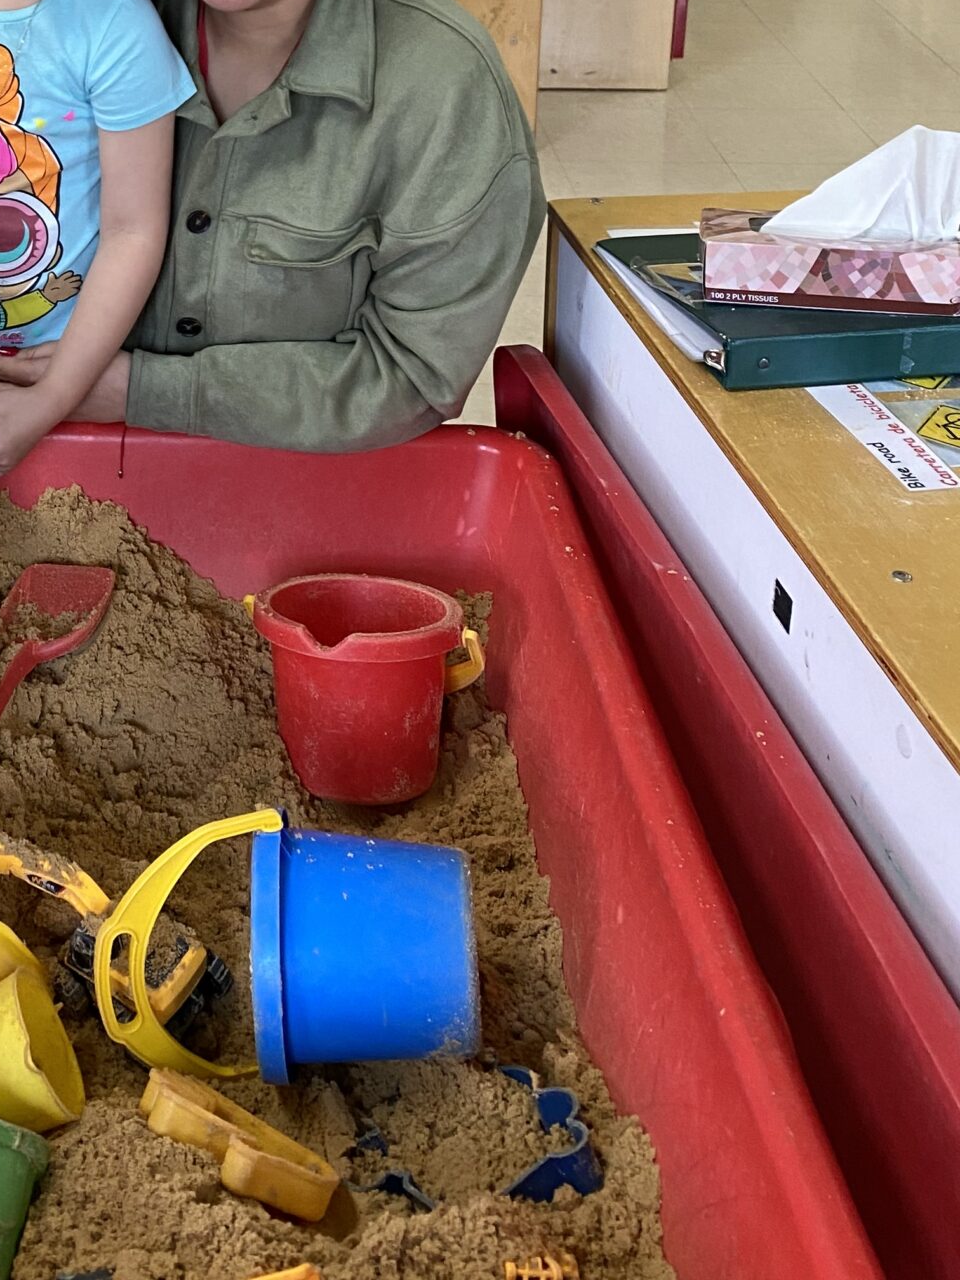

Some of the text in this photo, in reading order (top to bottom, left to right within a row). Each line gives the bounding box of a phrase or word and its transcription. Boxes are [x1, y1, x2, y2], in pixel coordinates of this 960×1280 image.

[747, 295, 779, 303] TISSUES
[846, 383, 959, 487] Carretera de bicicleta
[866, 441, 927, 489] Bike road
